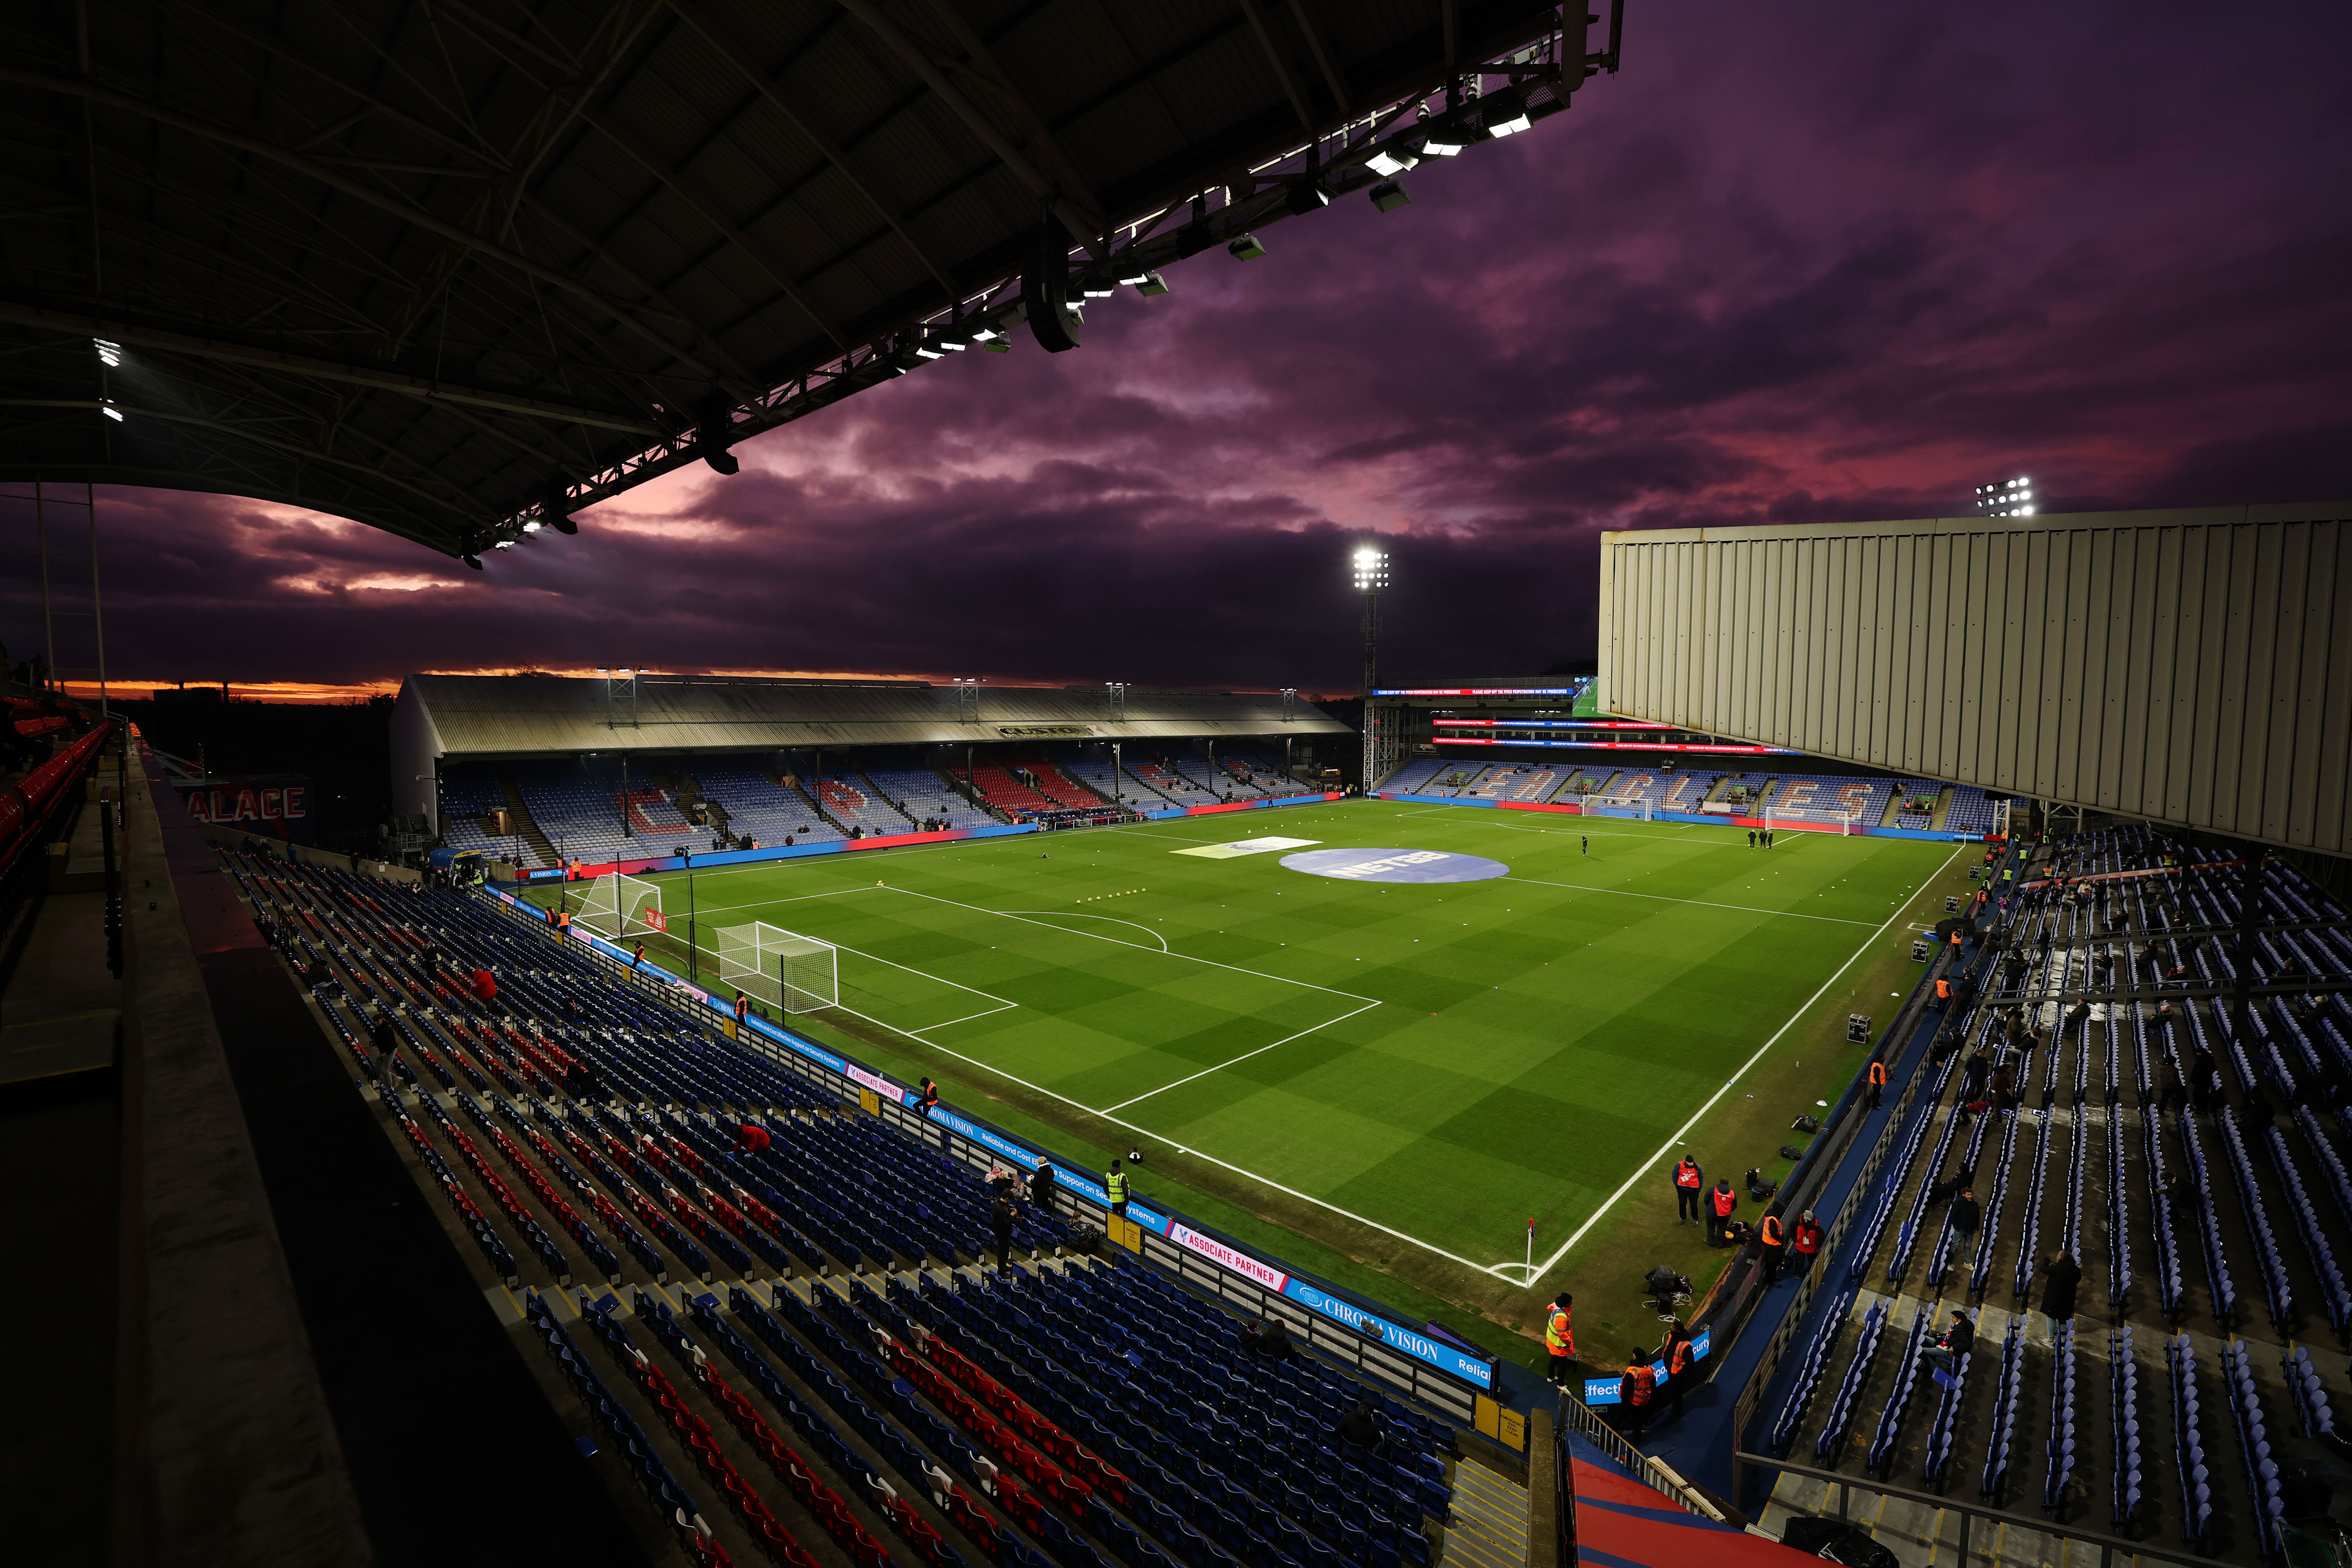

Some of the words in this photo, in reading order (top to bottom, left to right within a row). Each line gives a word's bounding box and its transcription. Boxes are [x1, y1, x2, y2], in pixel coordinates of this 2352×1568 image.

[177, 787, 305, 823] ALACE
[1327, 851, 1451, 877] NET88
[718, 1002, 734, 1016] CHROMA
[751, 1018, 763, 1028] Reliable
[777, 1032, 791, 1042] Effective
[791, 1038, 805, 1050] Support
[824, 1055, 839, 1068] Systems
[856, 1071, 878, 1088] ASSOCIATE
[879, 1083, 898, 1098] PARTNER
[951, 1116, 974, 1136] VISION
[982, 1133, 1004, 1149] Reliable
[1004, 1146, 1016, 1156] and
[1017, 1151, 1031, 1163] Cost
[1059, 1171, 1084, 1189] Support
[1085, 1186, 1094, 1194] on
[1189, 1235, 1232, 1264] ASSOCIATE
[1236, 1257, 1274, 1284] PARTNER
[1302, 1290, 1319, 1300] CHROMA
[1388, 1326, 1438, 1361] VISION
[1500, 1414, 1524, 1428] EMERGENCY
[1505, 1429, 1518, 1438] CLEAR
